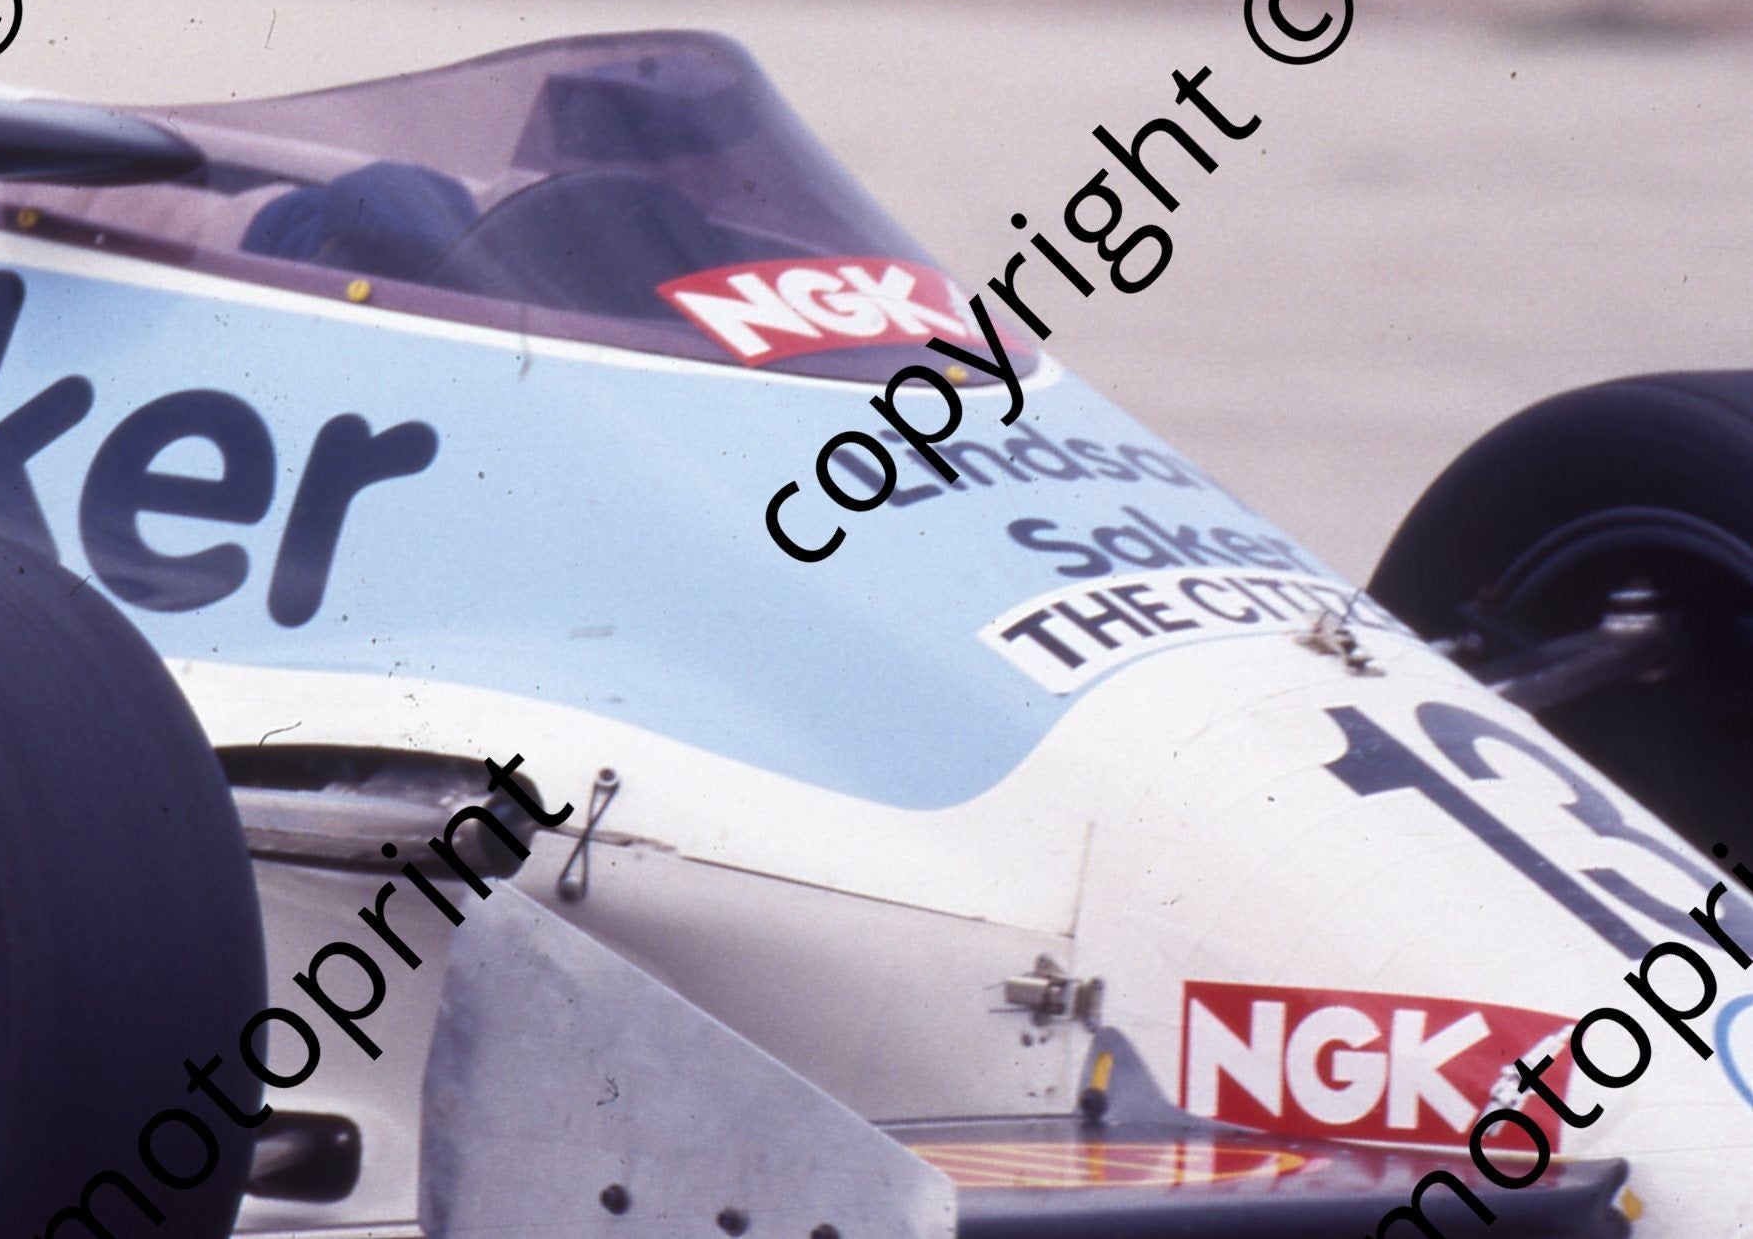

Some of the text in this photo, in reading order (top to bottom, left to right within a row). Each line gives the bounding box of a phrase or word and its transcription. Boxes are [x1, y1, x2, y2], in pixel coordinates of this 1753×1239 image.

[673, 264, 969, 358] NGK
[831, 419, 1254, 511] Lindsa
[999, 583, 1214, 670] THE
[1323, 701, 1753, 961] 13
[1187, 997, 1491, 1135] NGK
